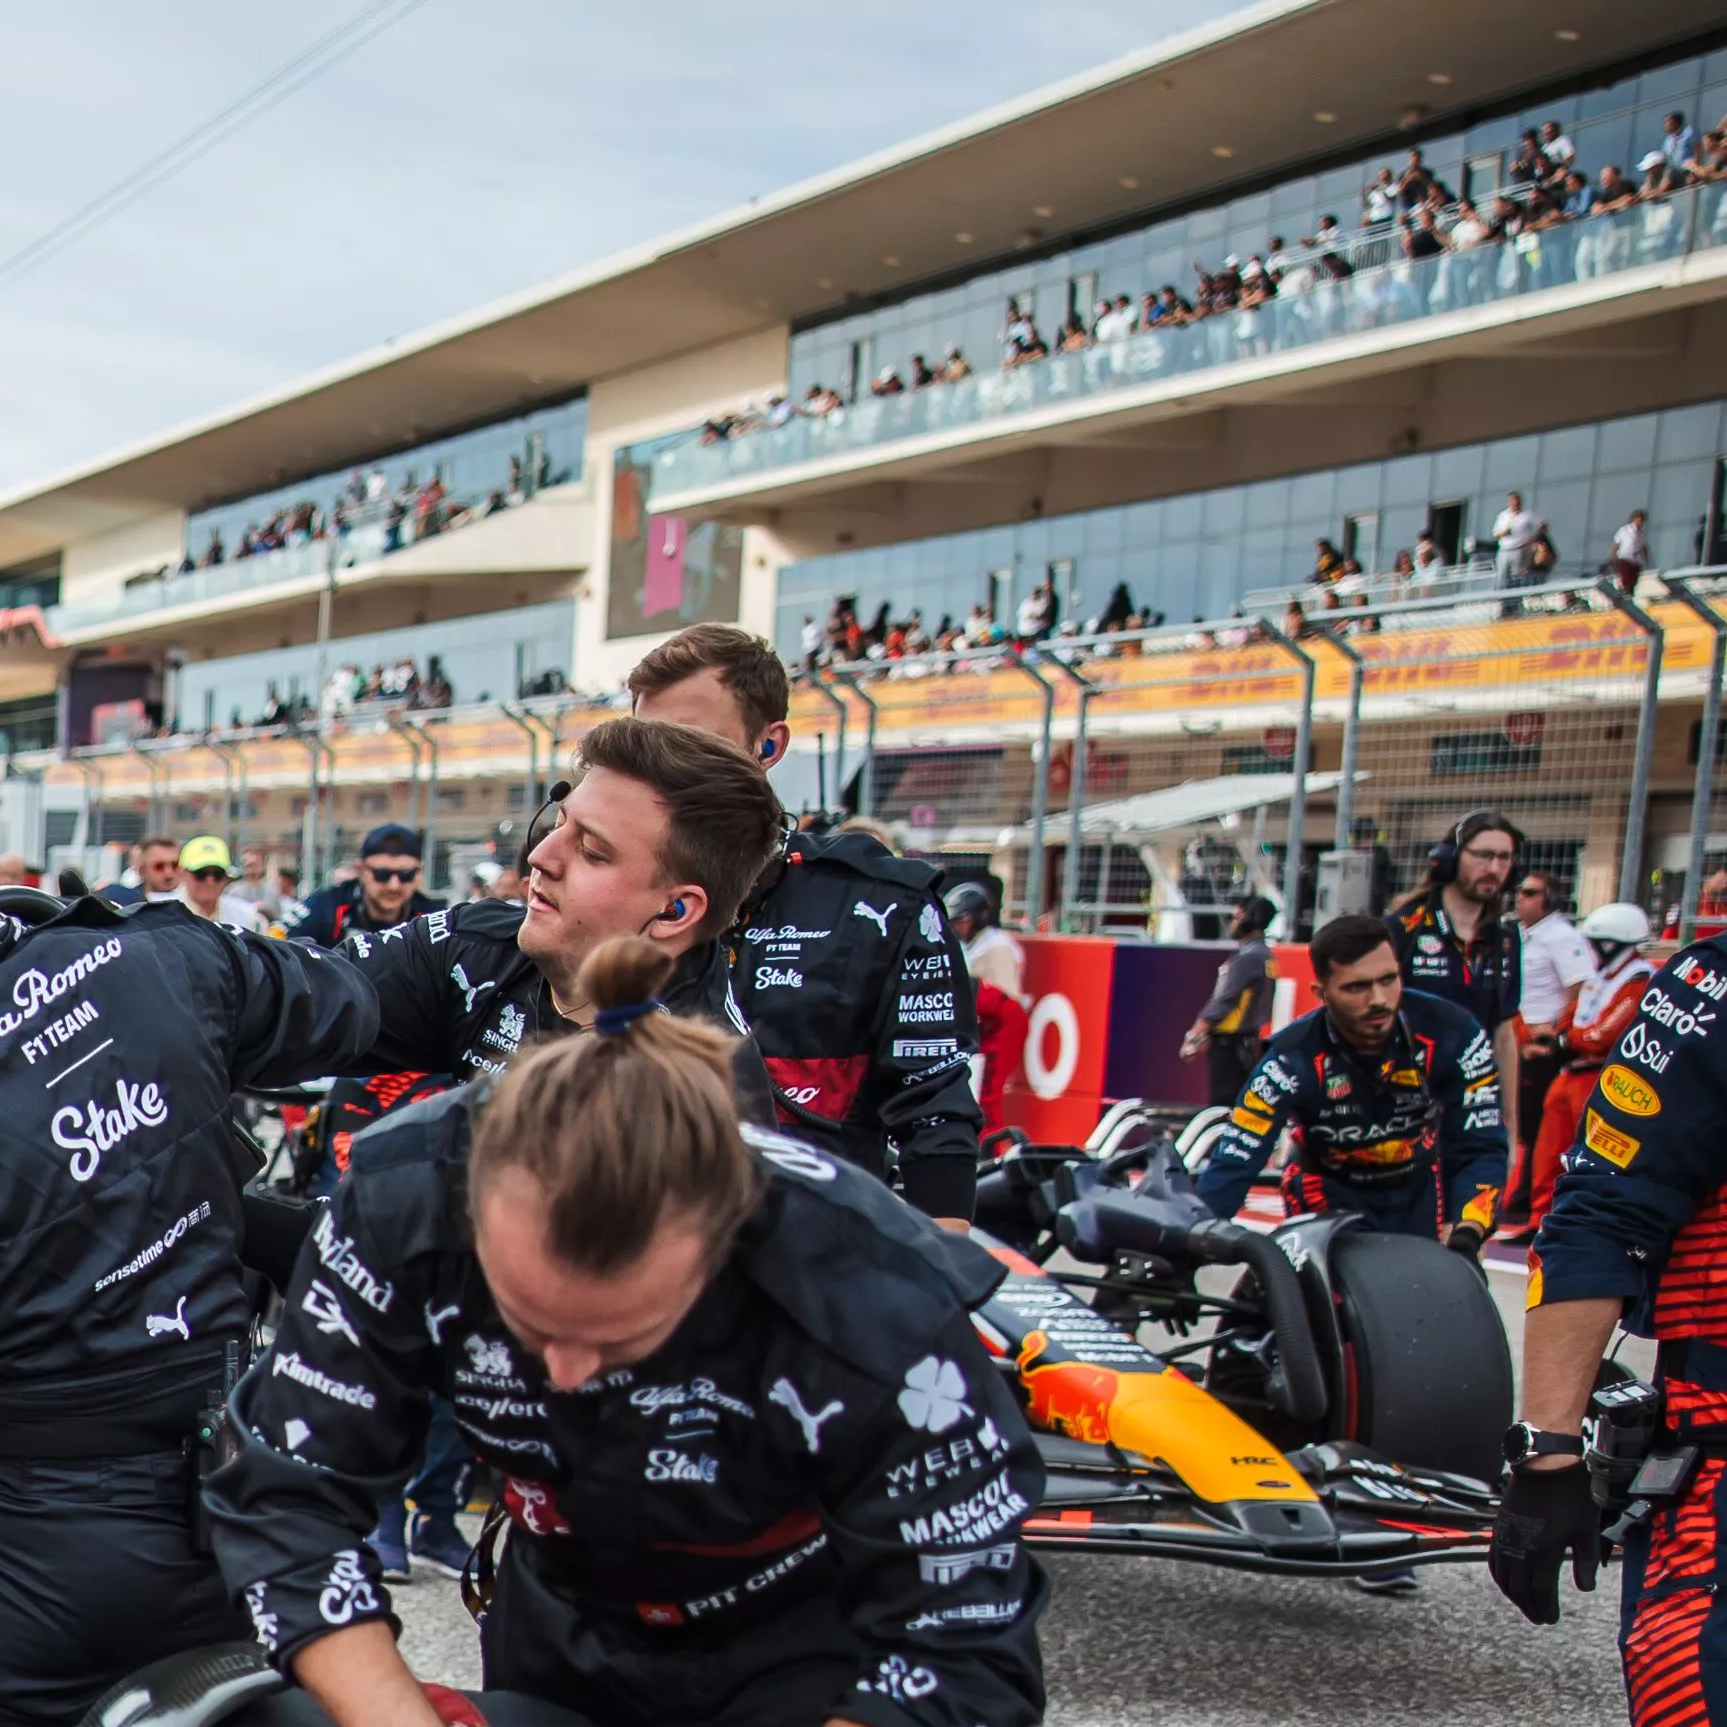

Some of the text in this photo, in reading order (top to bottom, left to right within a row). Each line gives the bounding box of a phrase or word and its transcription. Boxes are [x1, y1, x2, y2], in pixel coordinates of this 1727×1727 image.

[745, 925, 832, 945] Alfa Romeo
[13, 937, 122, 1020] Romeo
[754, 966, 803, 990] Stake
[898, 992, 953, 1010] MASCO
[1640, 987, 1696, 1036] Claro
[21, 1000, 99, 1065] F1 TEAM
[484, 1028, 519, 1052] SINGH
[1640, 1039, 1674, 1074] Sui
[1611, 1073, 1651, 1110] RAUCH
[52, 1079, 169, 1182] Stake
[95, 1239, 164, 1293] sensetime
[644, 1448, 720, 1484] Stake
[685, 1531, 831, 1619] PIT CREW
